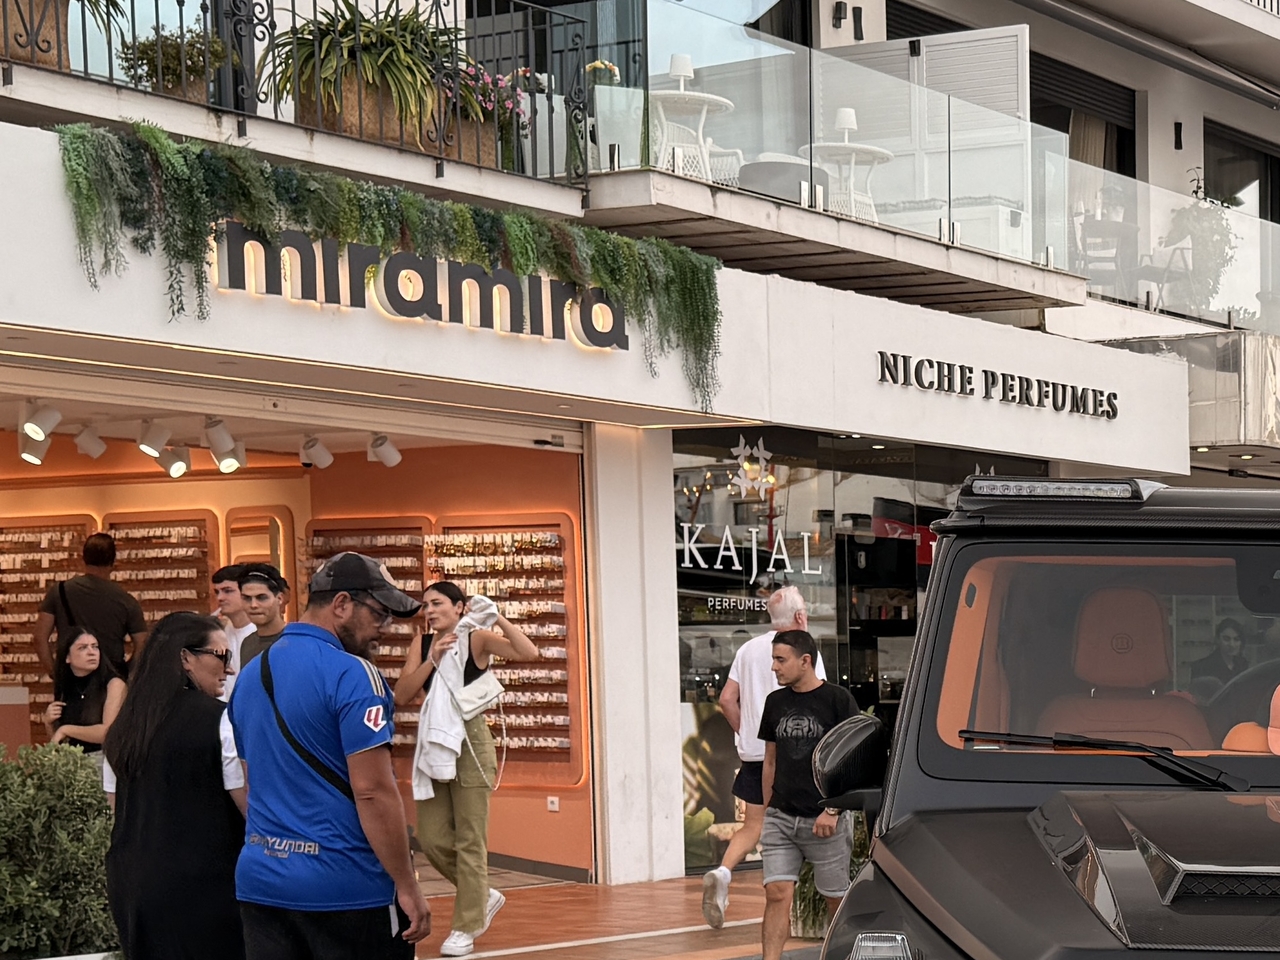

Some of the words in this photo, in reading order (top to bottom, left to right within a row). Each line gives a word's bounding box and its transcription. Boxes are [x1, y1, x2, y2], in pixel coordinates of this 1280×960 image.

[877, 350, 975, 396] NICHE
[981, 369, 1118, 420] PERFUMES
[680, 522, 822, 584] KAJAL
[707, 597, 767, 611] PERFUMES
